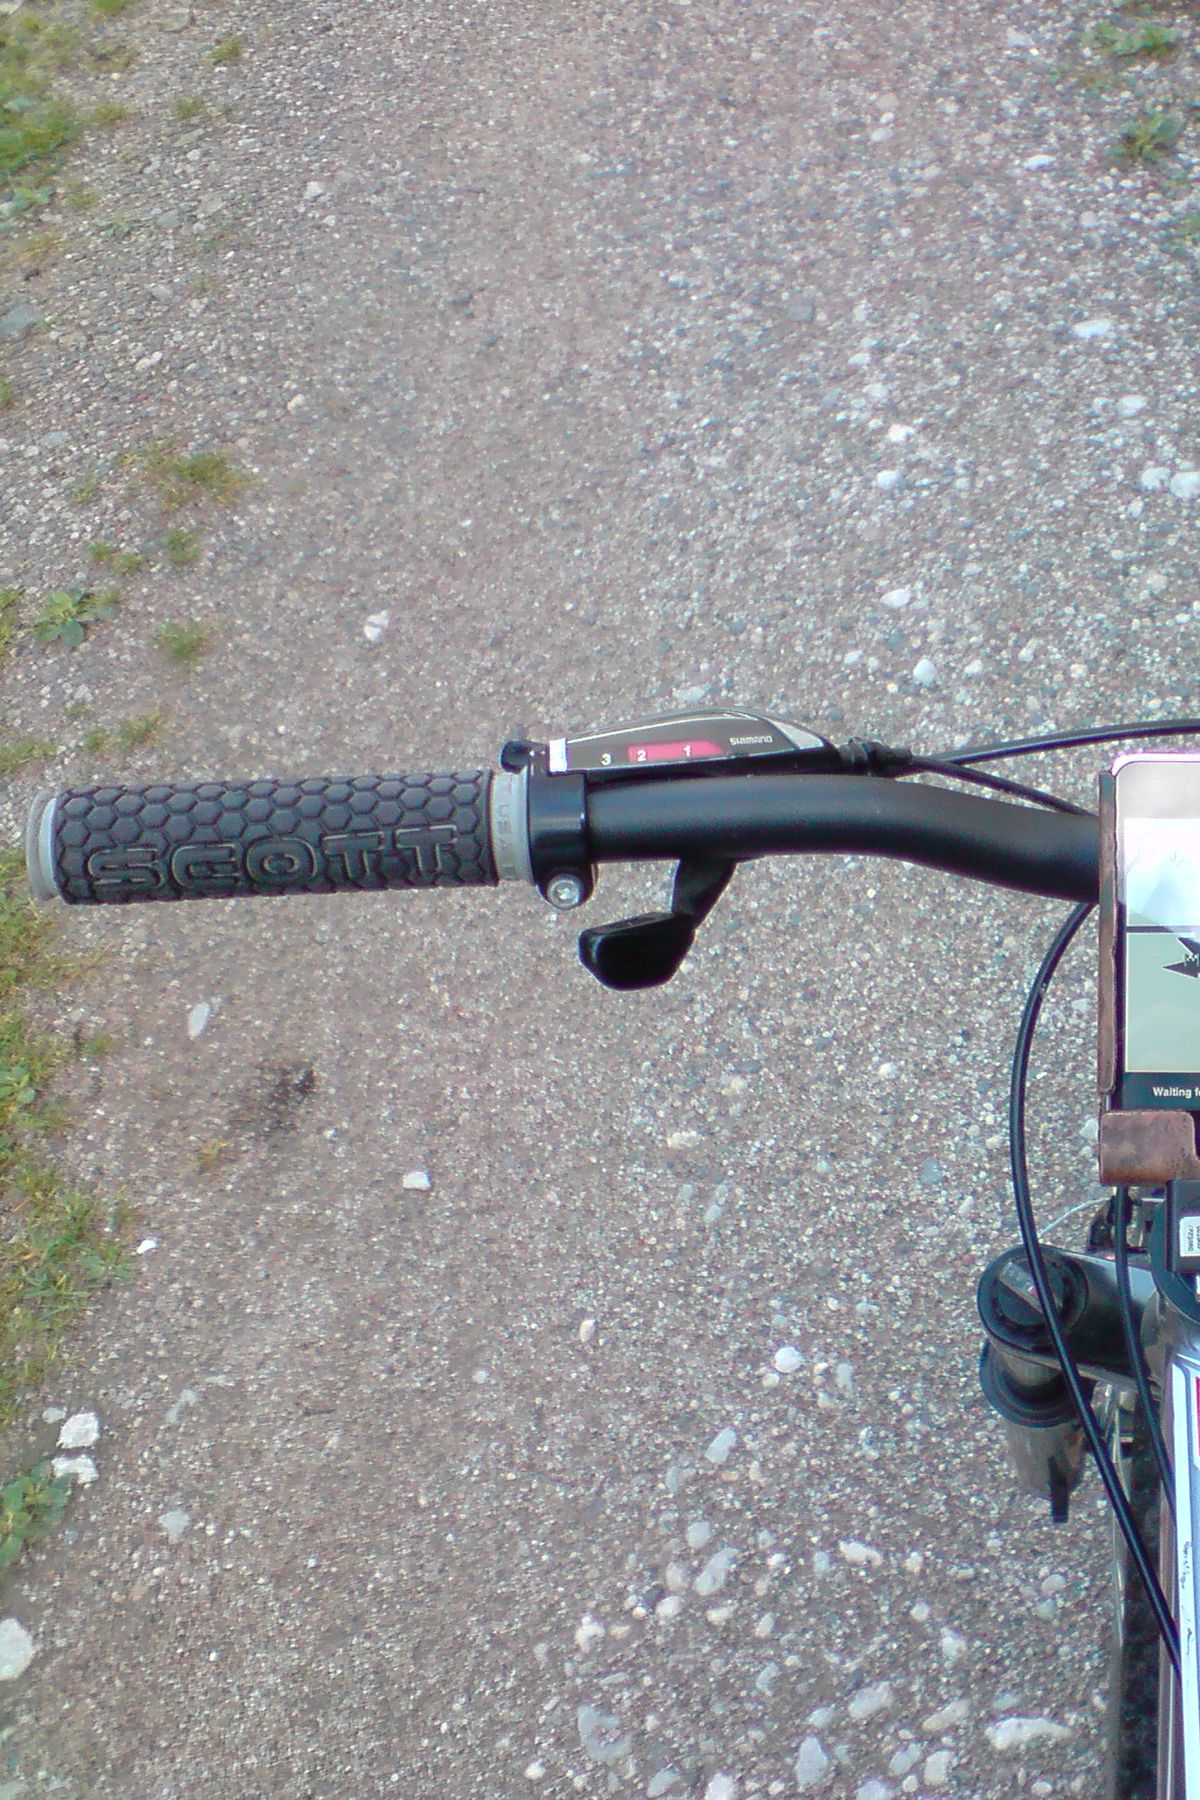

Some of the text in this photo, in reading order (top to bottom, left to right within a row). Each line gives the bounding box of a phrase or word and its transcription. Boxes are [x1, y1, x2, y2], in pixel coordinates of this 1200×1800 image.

[729, 734, 773, 746] SHIMANO
[600, 744, 692, 766] 3 2 1
[87, 823, 458, 888] SCOTT
[1152, 1086, 1192, 1099] Waiting
